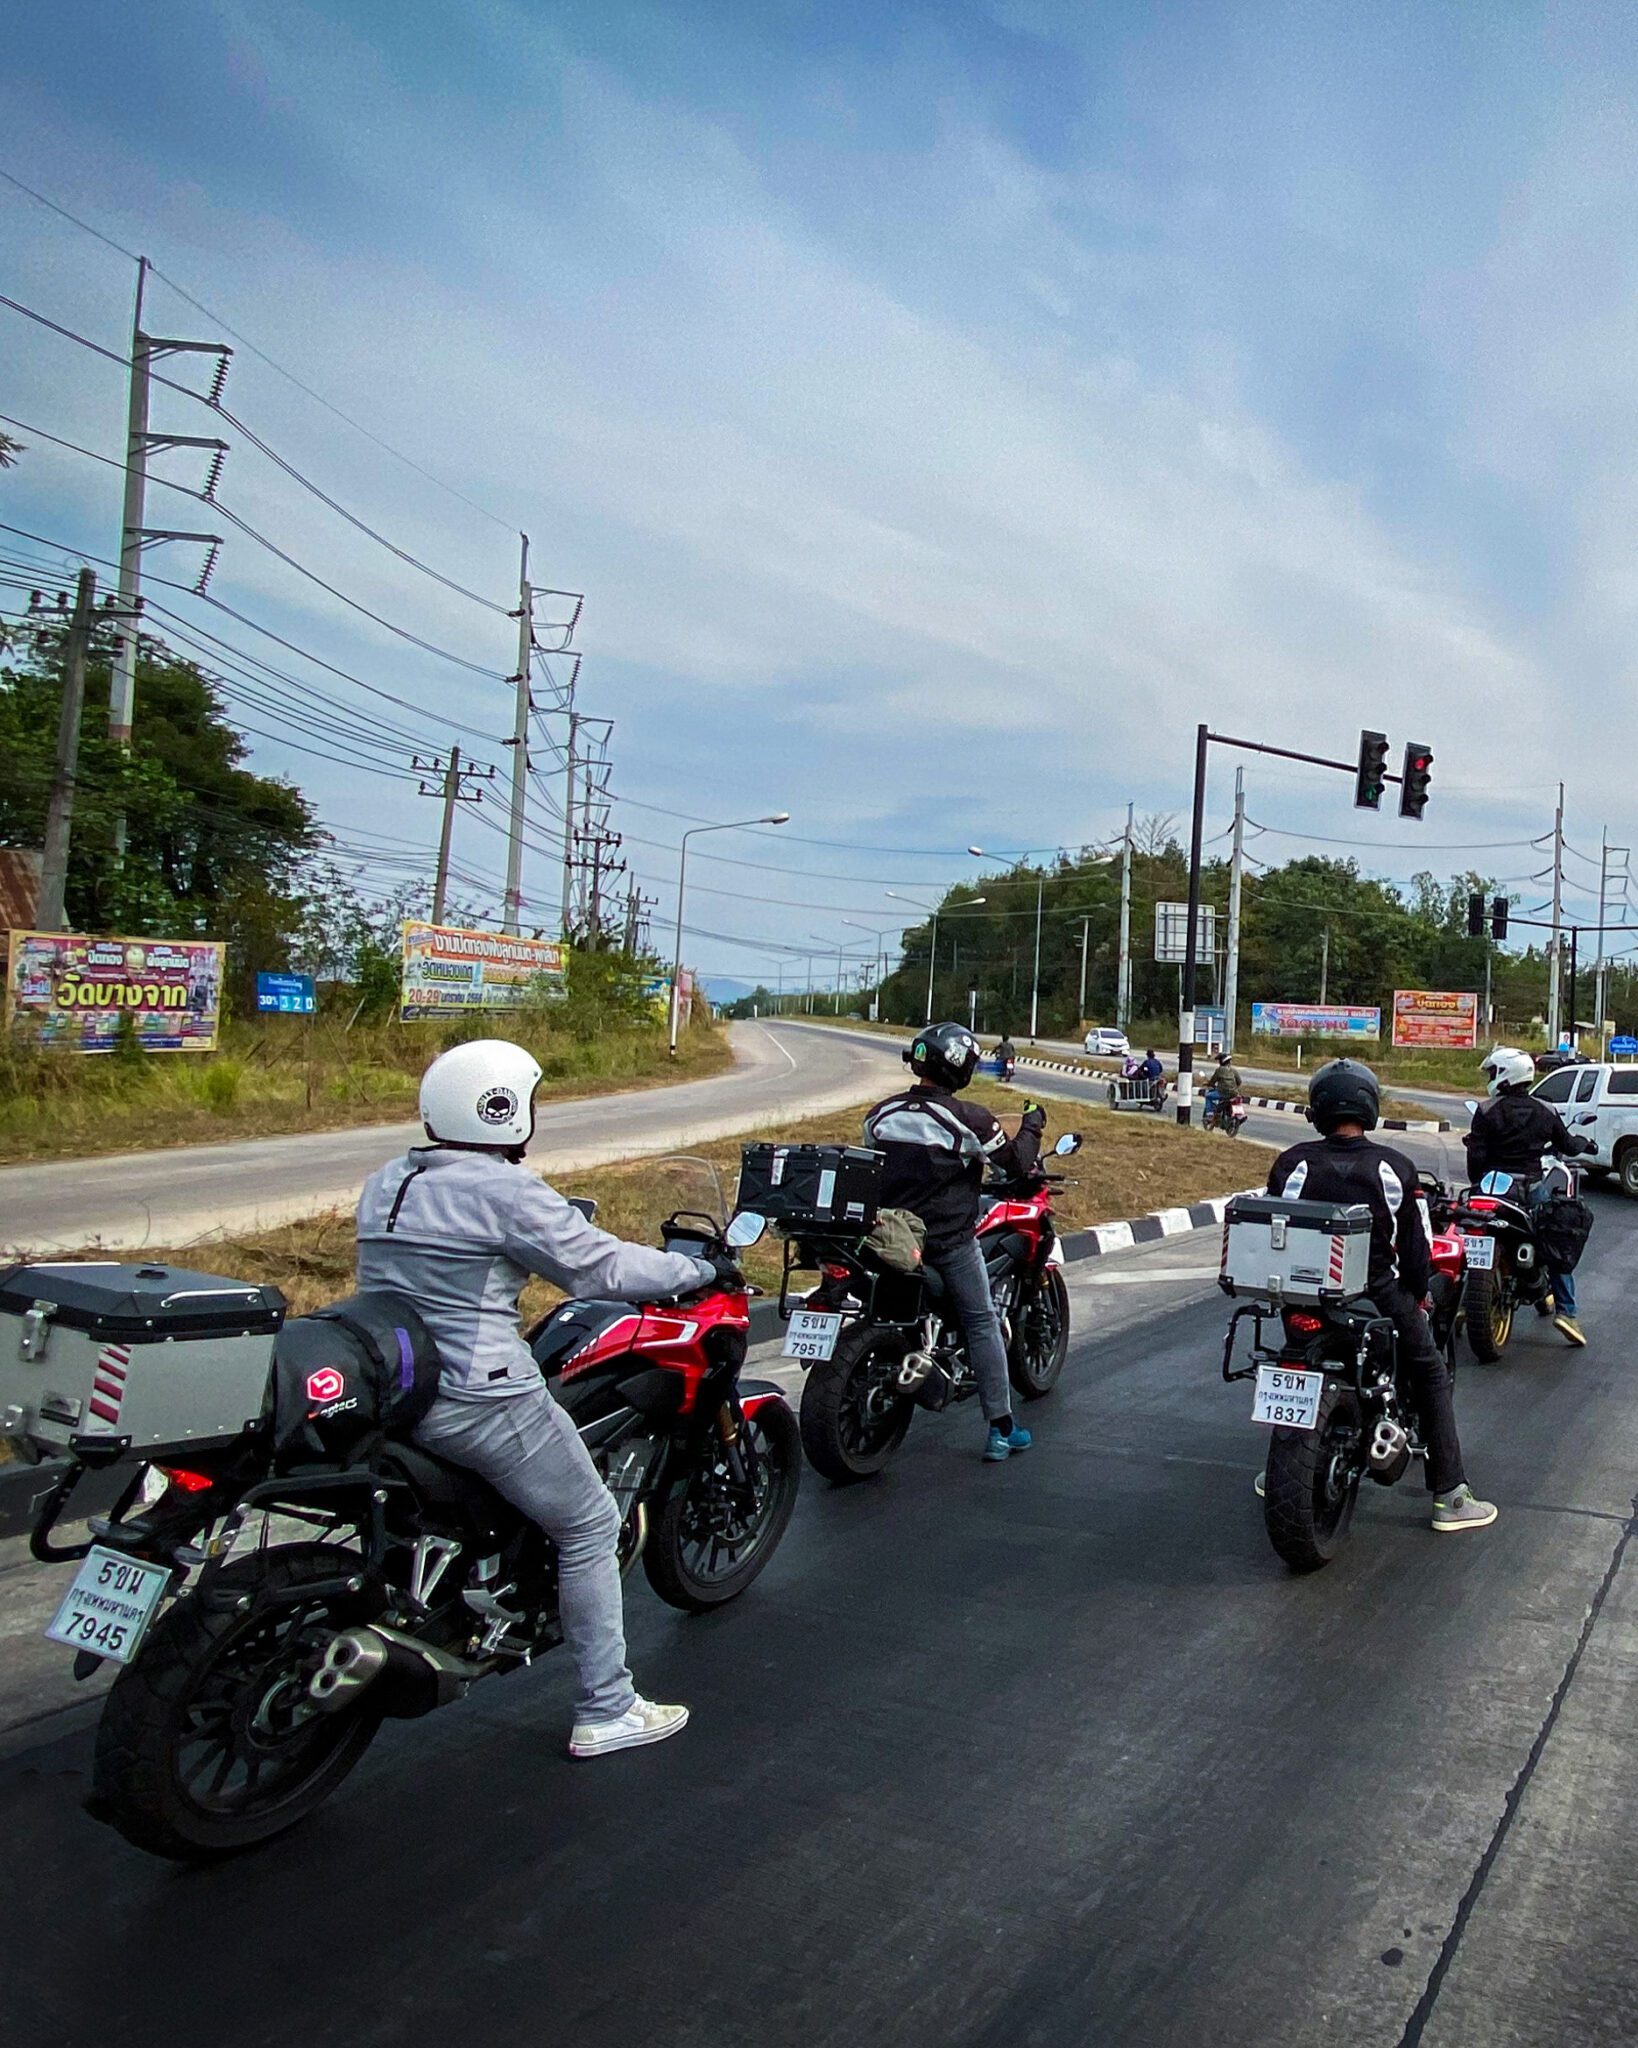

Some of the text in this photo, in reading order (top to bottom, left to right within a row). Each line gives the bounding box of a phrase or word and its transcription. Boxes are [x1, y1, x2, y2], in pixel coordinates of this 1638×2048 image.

[57, 972, 188, 1007] วัดบางจาก
[409, 988, 439, 1003] 20-29
[792, 1343, 823, 1356] 7951
[1266, 1405, 1307, 1423] 1837
[69, 1588, 144, 1623] กรุงเทพมหานคร
[65, 1612, 128, 1650] 7945
